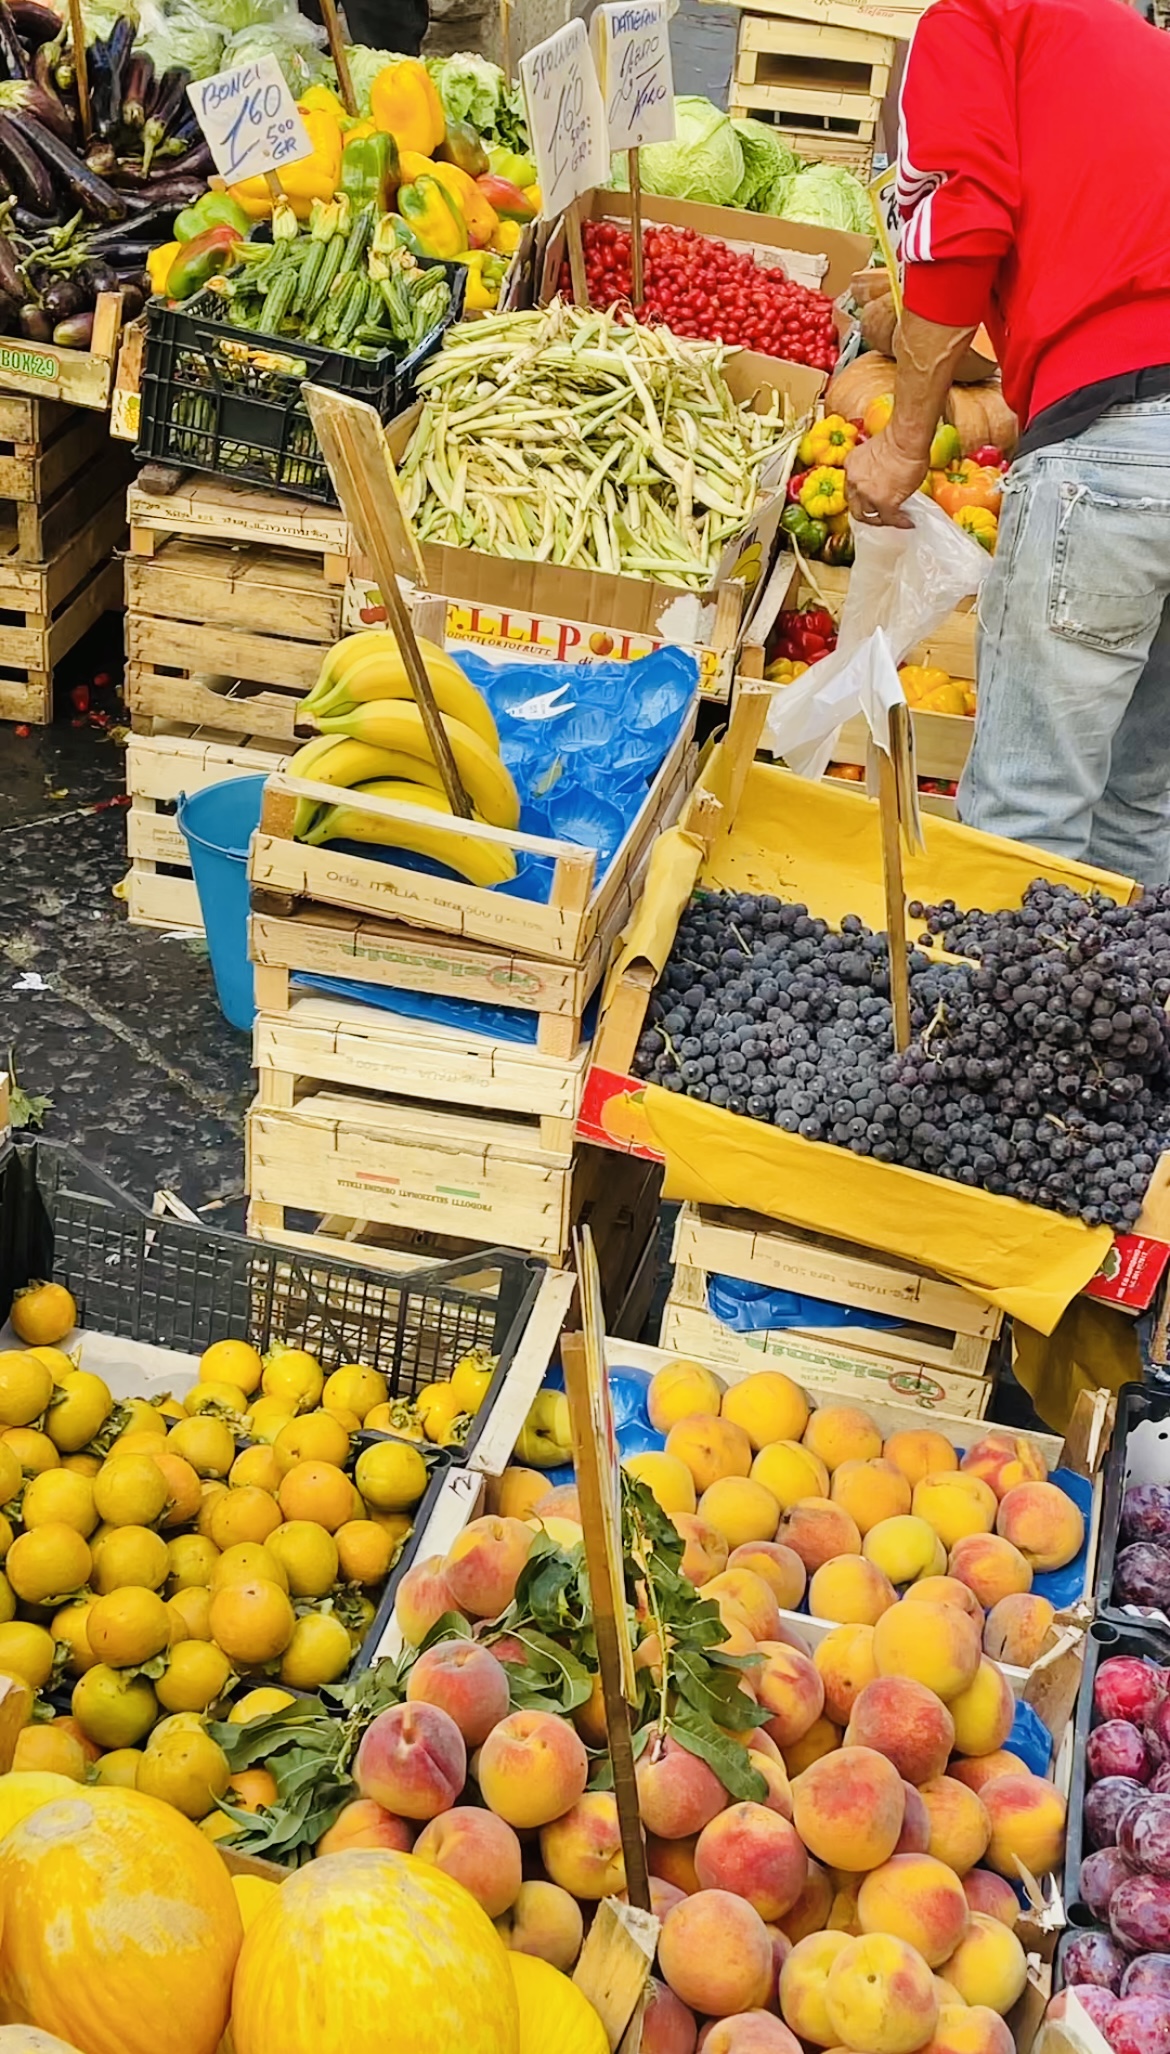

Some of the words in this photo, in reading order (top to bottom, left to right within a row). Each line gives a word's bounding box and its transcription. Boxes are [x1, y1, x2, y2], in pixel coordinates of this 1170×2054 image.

[267, 119, 295, 145] 500
[272, 137, 298, 160] GR
[326, 870, 364, 888] Orig.
[369, 880, 419, 901] ITALIA
[337, 1178, 363, 1190] ITALIA
[364, 1183, 397, 1196] ORIGINE
[398, 1189, 450, 1205] SELEZIONATI
[451, 1198, 493, 1213] PRODOTTI
[809, 1270, 836, 1283] tara
